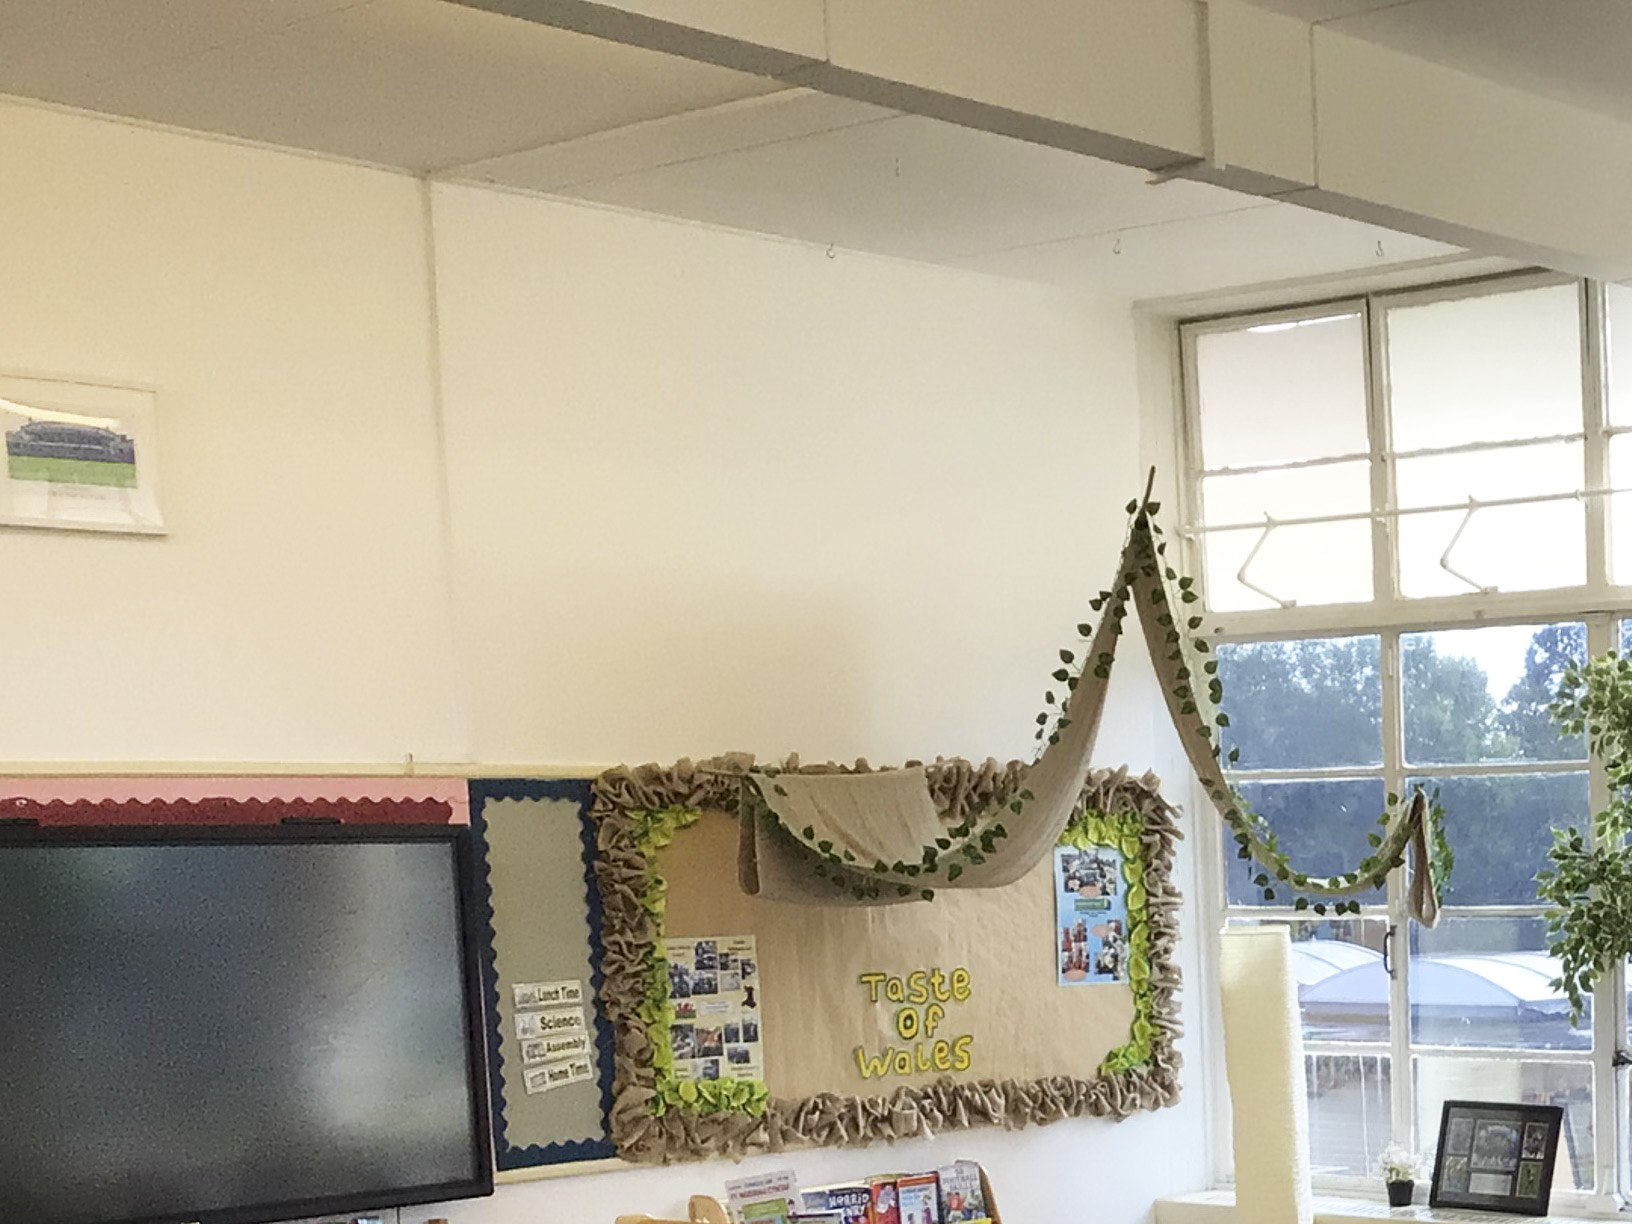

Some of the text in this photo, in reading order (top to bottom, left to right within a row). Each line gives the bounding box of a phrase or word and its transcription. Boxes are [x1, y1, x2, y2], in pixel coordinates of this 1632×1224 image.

[858, 967, 972, 1004] Taste
[538, 986, 580, 1001] Lunch Time
[540, 1016, 582, 1030] Science
[546, 1038, 586, 1053] Assembly
[547, 1063, 590, 1081] Home Time
[828, 1192, 870, 1208] HORRID
